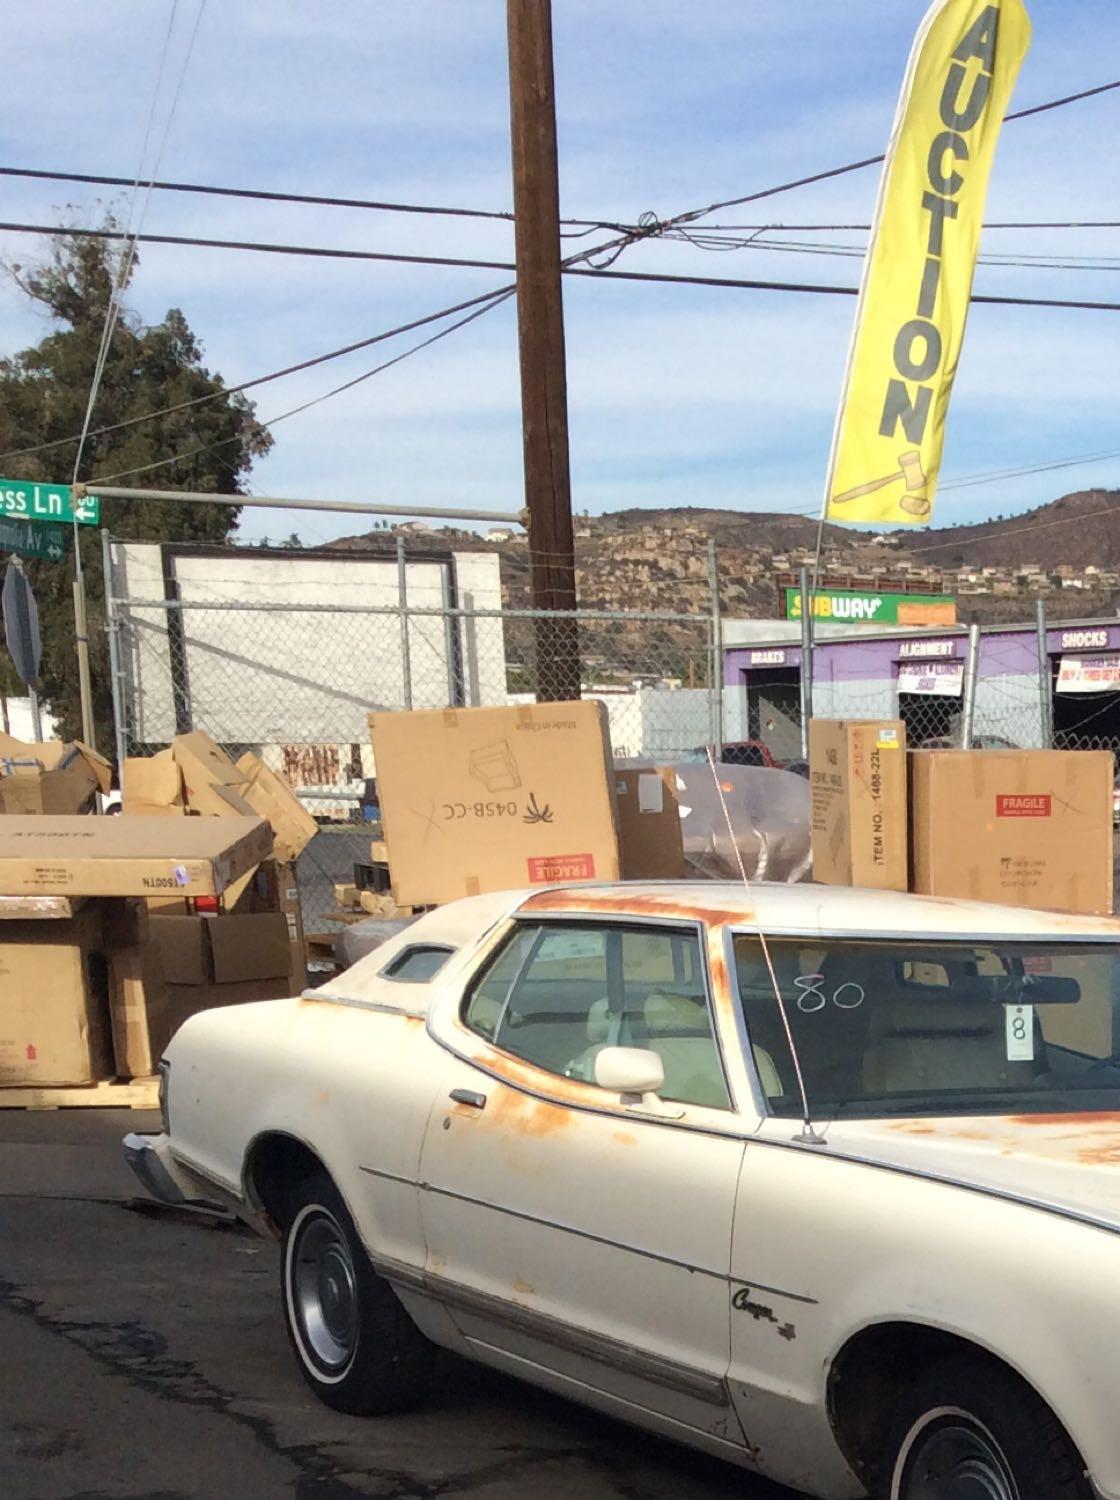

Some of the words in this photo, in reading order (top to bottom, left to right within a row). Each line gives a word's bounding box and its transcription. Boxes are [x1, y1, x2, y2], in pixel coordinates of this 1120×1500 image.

[878, 4, 999, 446] AUCTION
[34, 486, 62, 515] Ln
[790, 594, 882, 618] SUBWAY
[900, 641, 953, 656] ALIGNMENT
[1061, 631, 1107, 649] SHOCKS
[751, 651, 784, 664] BRAKES
[442, 801, 517, 820] 045B-CC
[1002, 798, 1045, 808] FRAGILE
[872, 836, 884, 865] ITEM
[536, 864, 587, 878] FRAGILE
[794, 974, 865, 1012] 80
[1012, 1017, 1026, 1040] 8
